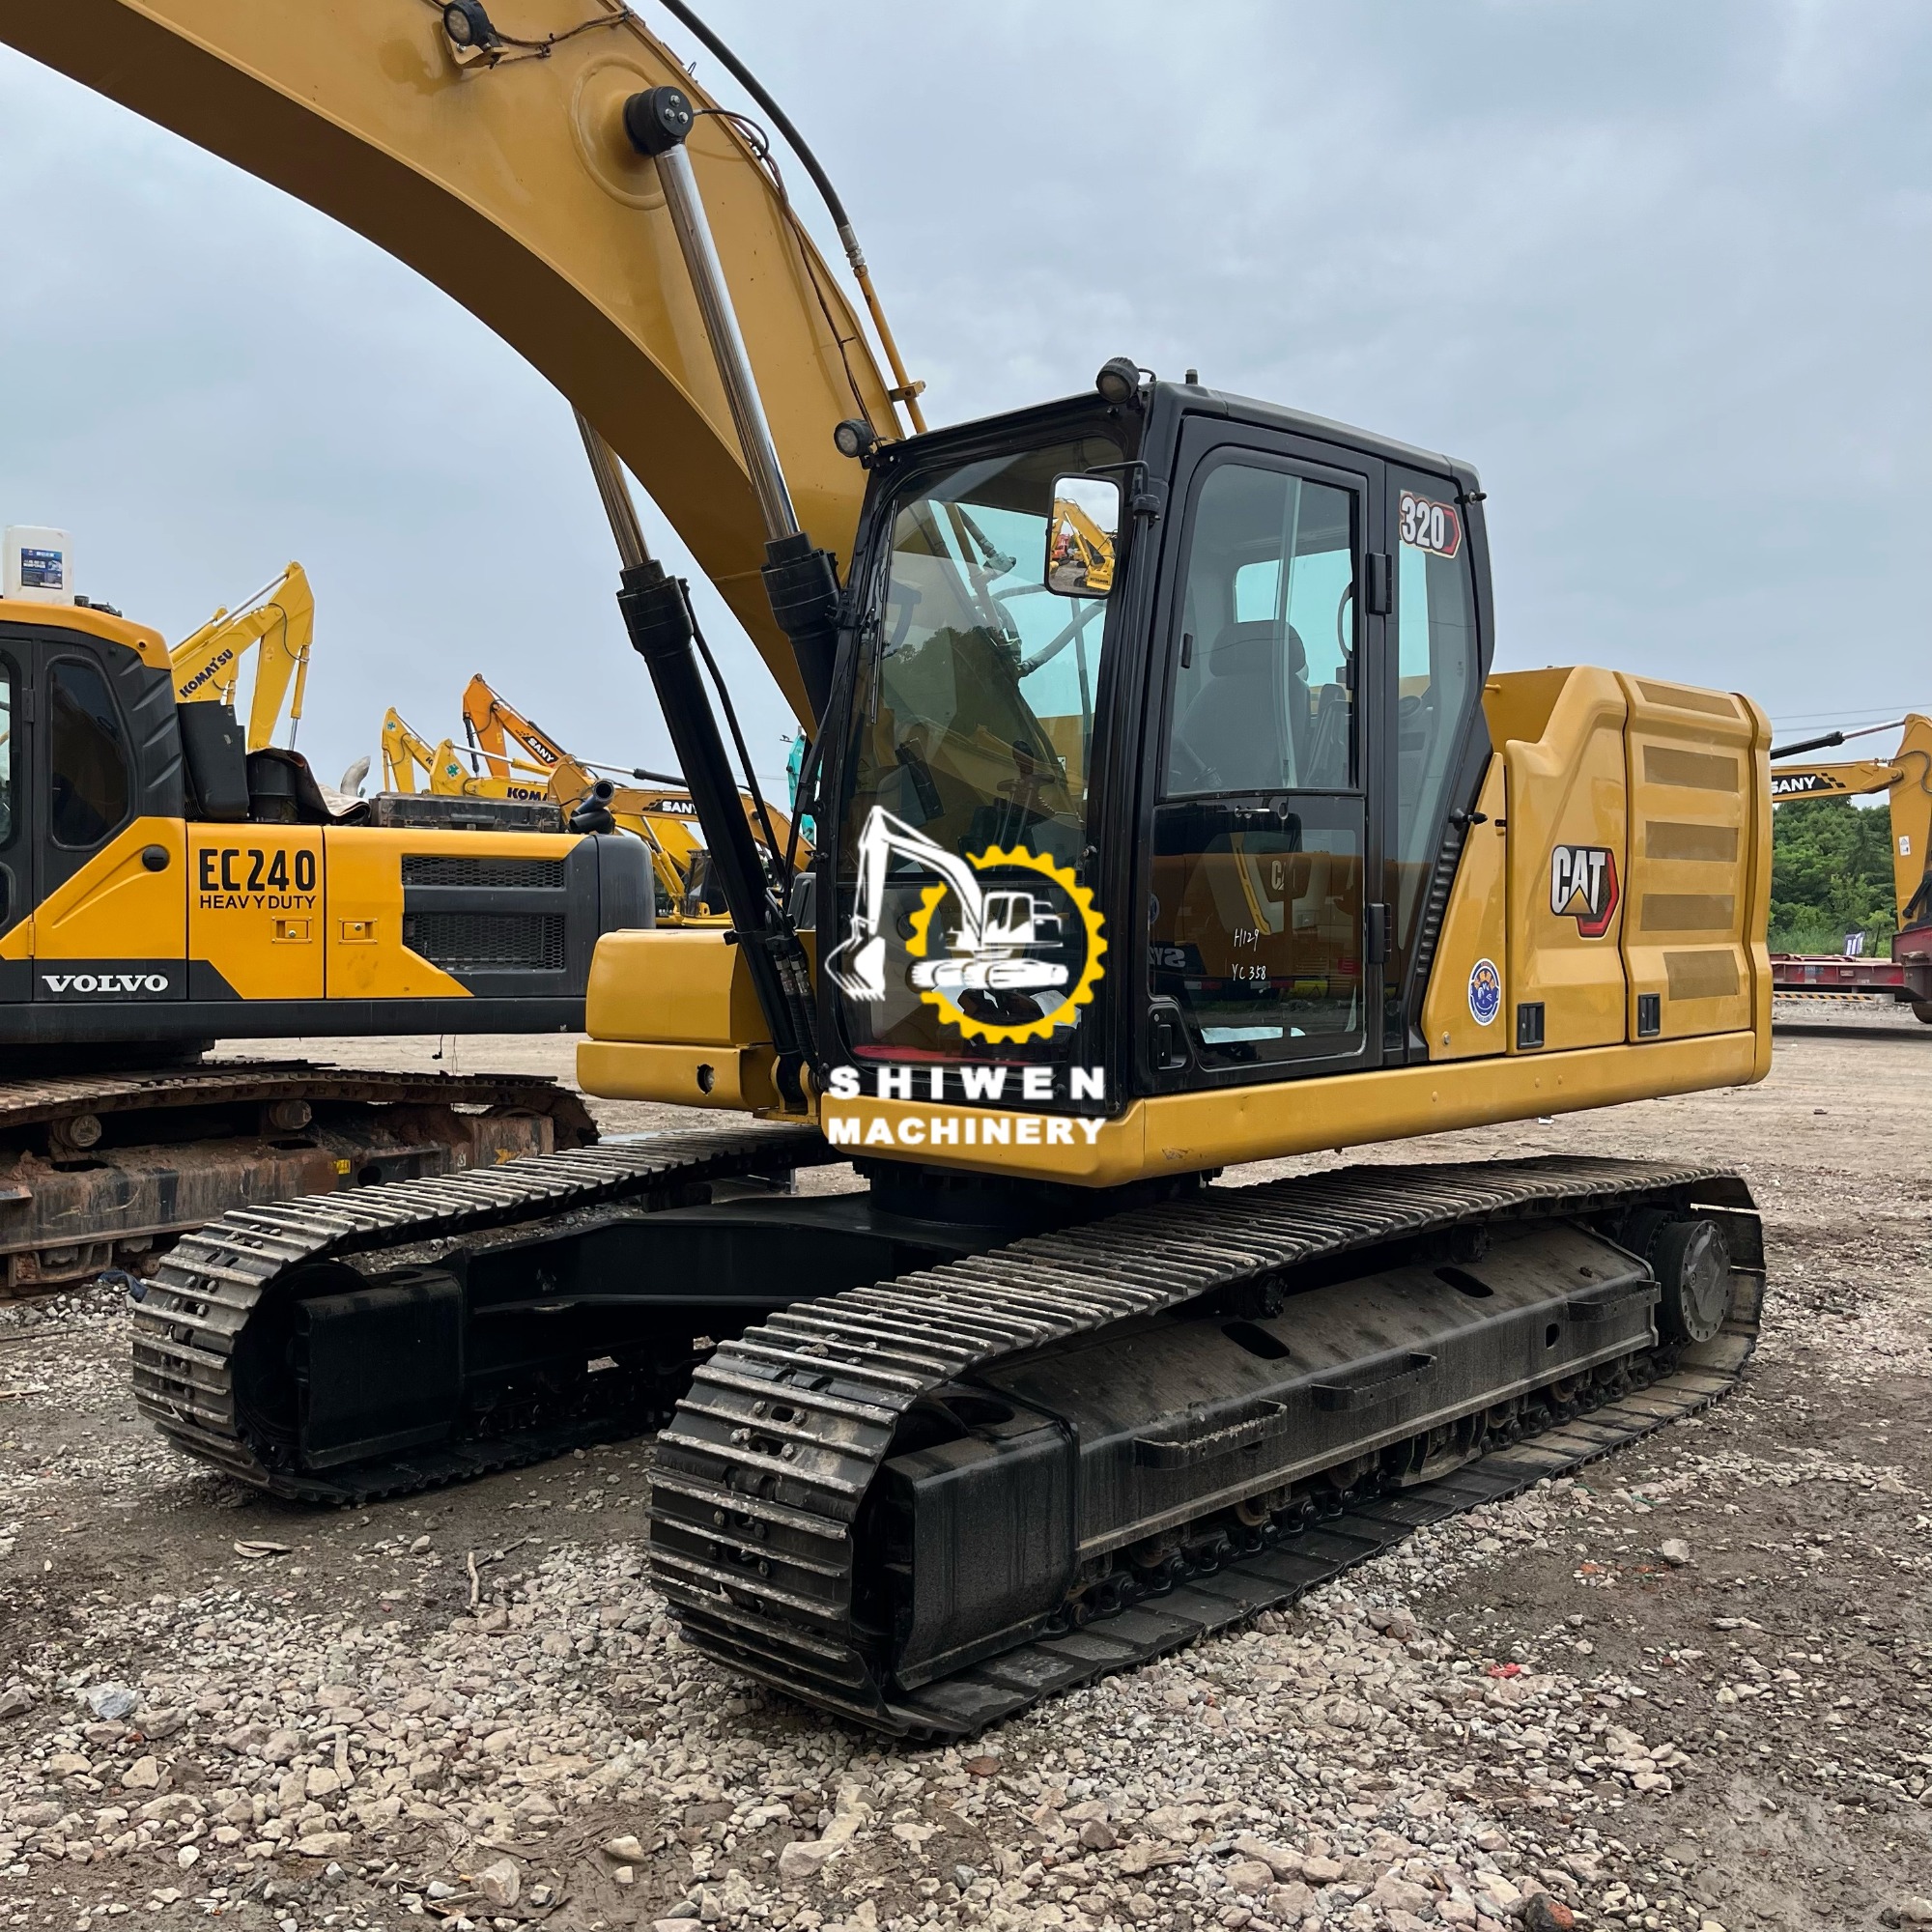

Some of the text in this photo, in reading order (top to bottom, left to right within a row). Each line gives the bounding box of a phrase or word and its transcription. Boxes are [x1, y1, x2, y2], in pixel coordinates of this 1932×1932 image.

[1401, 497, 1445, 550] 320
[179, 648, 234, 698] KOMATSU
[527, 737, 554, 762] SANY
[199, 848, 316, 892] EC240
[1551, 846, 1605, 915] CAT
[42, 975, 168, 992] VOLVO
